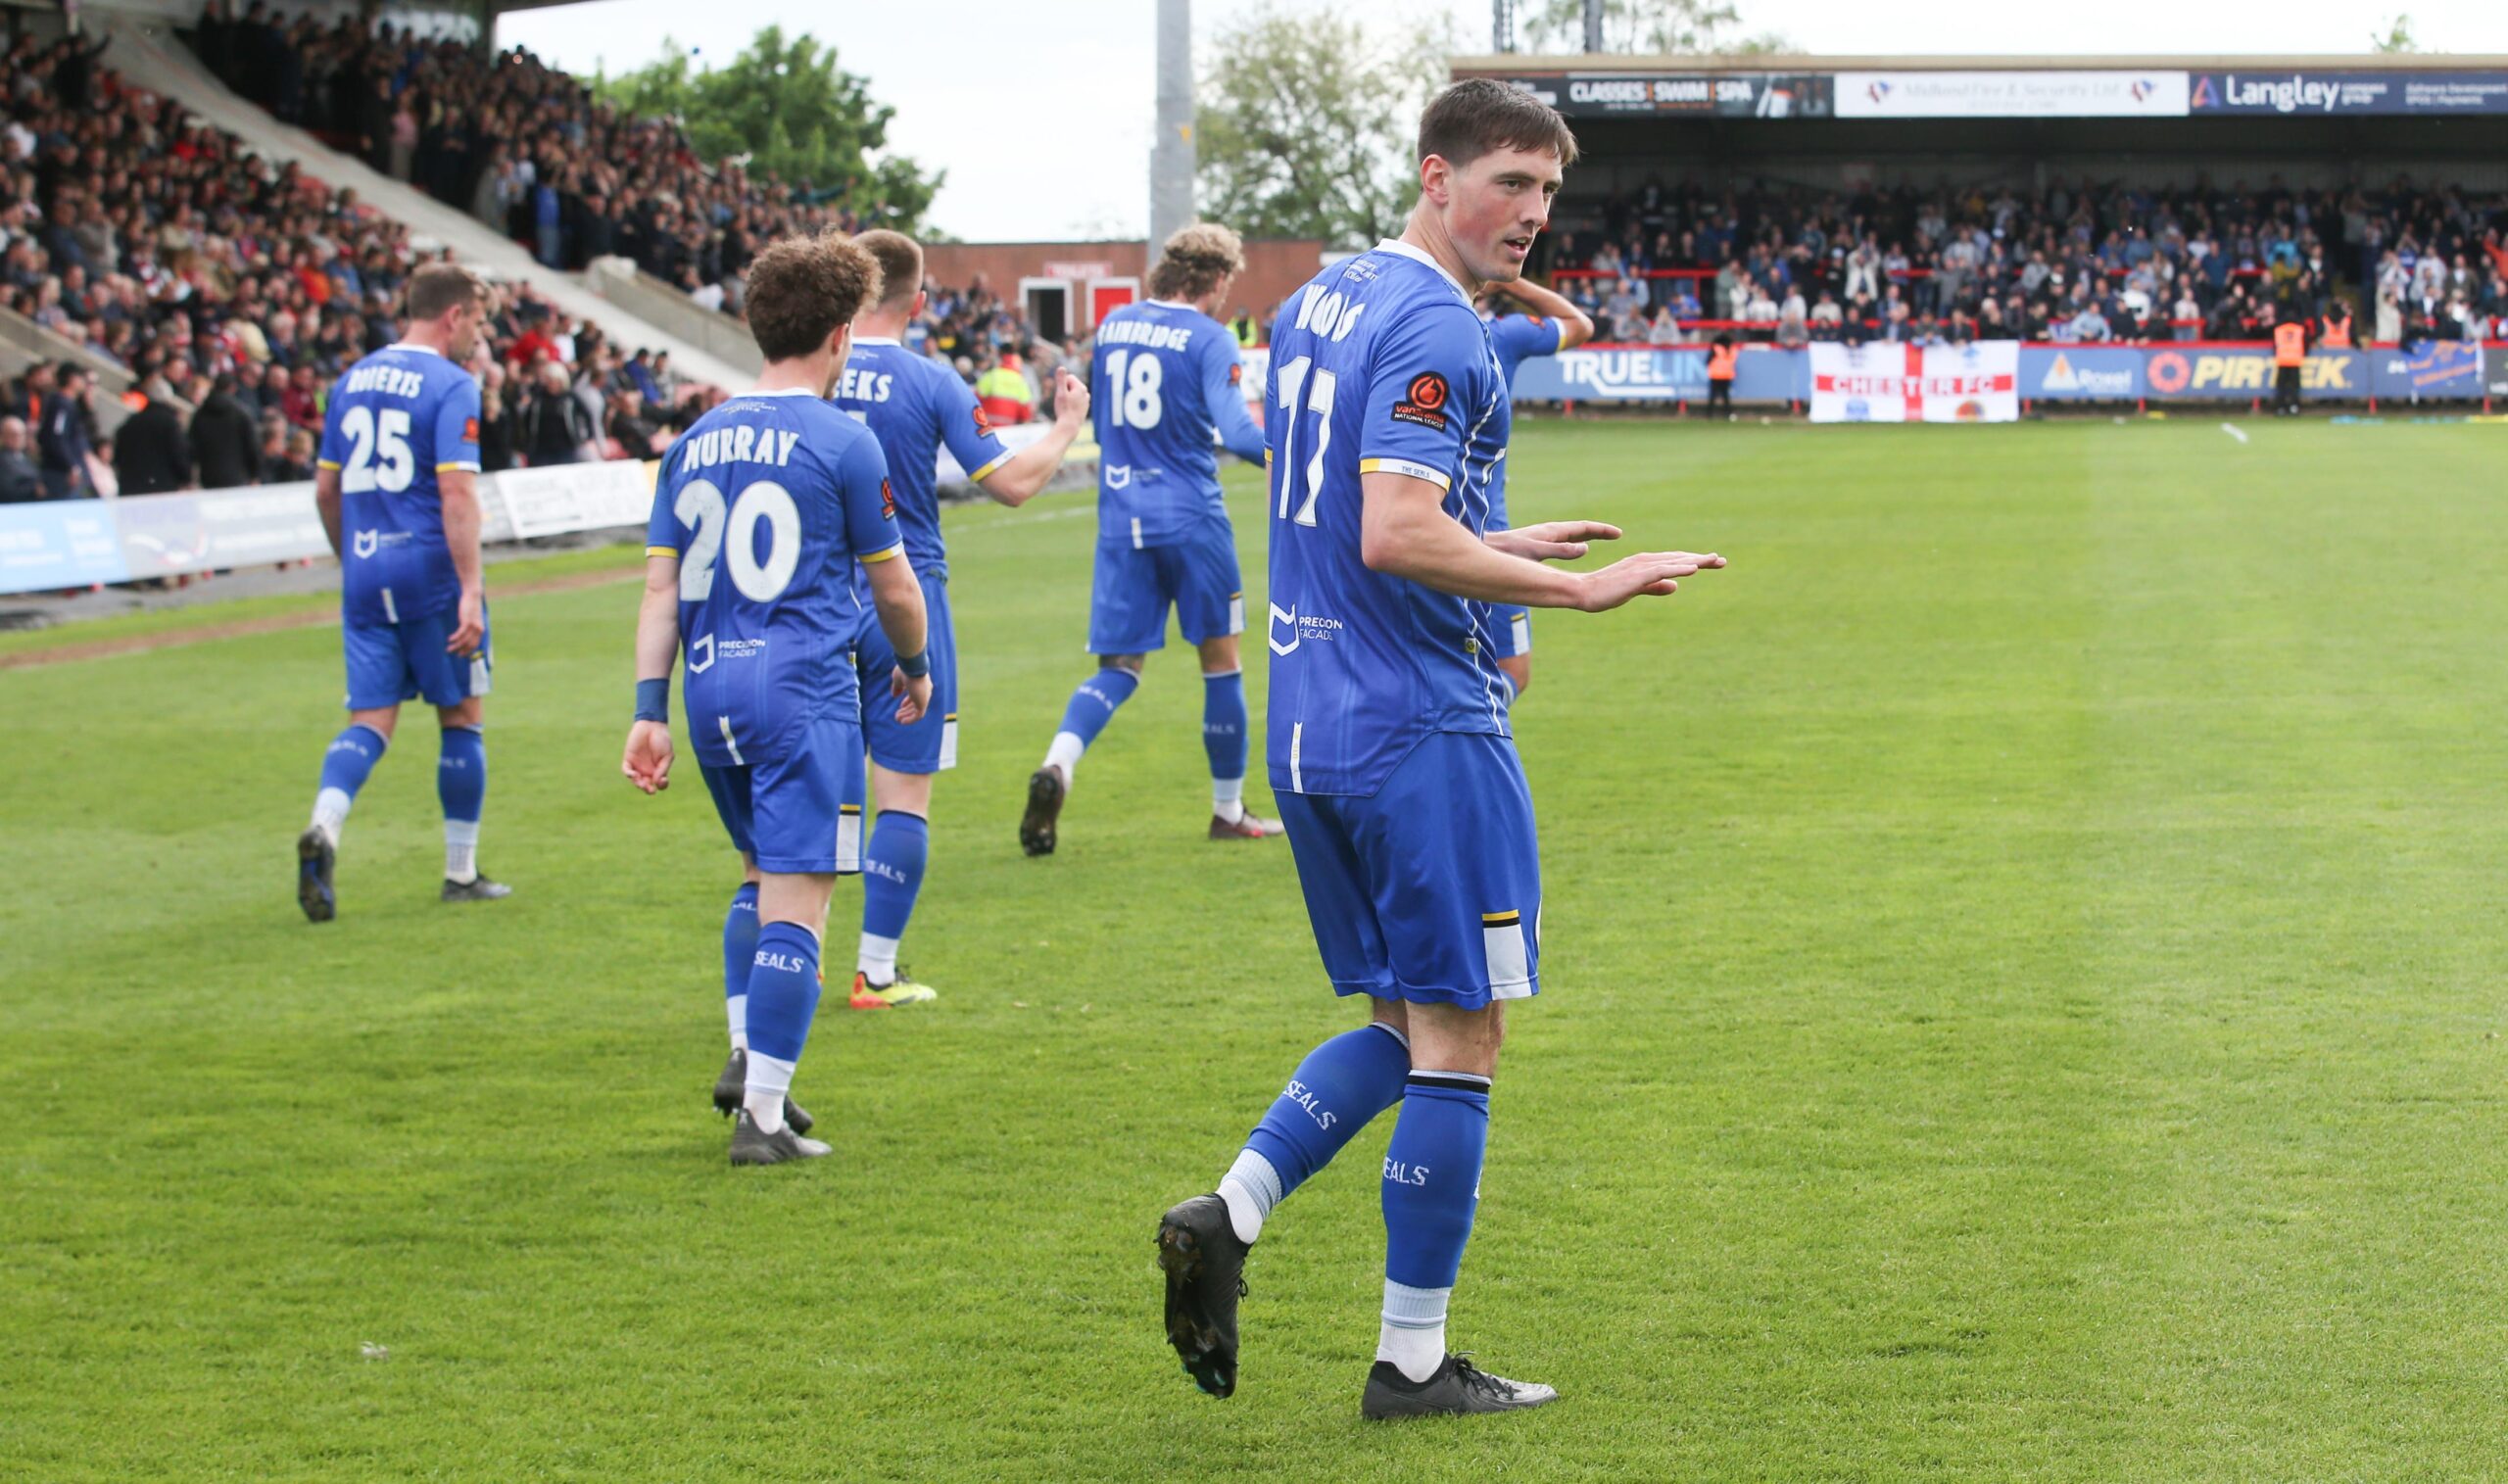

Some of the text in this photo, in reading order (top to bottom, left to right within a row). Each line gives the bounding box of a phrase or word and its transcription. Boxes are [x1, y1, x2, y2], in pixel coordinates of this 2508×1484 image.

[1569, 80, 1647, 103] CLASSES
[1654, 81, 1709, 102] SWIM
[1715, 81, 1754, 102] SPA
[2226, 74, 2339, 112] Langley
[1556, 351, 1710, 384] TRUELIN
[1105, 349, 1162, 430] 18
[1832, 374, 1995, 397] CHESTER FC
[1394, 413, 1423, 422] NATIONAL
[340, 406, 414, 493] 25
[682, 425, 799, 473] MURRAY
[1402, 465, 1413, 474] THE
[673, 478, 801, 603] 20
[753, 950, 804, 973] SEALS
[1282, 1079, 1337, 1130] SEALS
[1383, 1156, 1429, 1186] EALS
